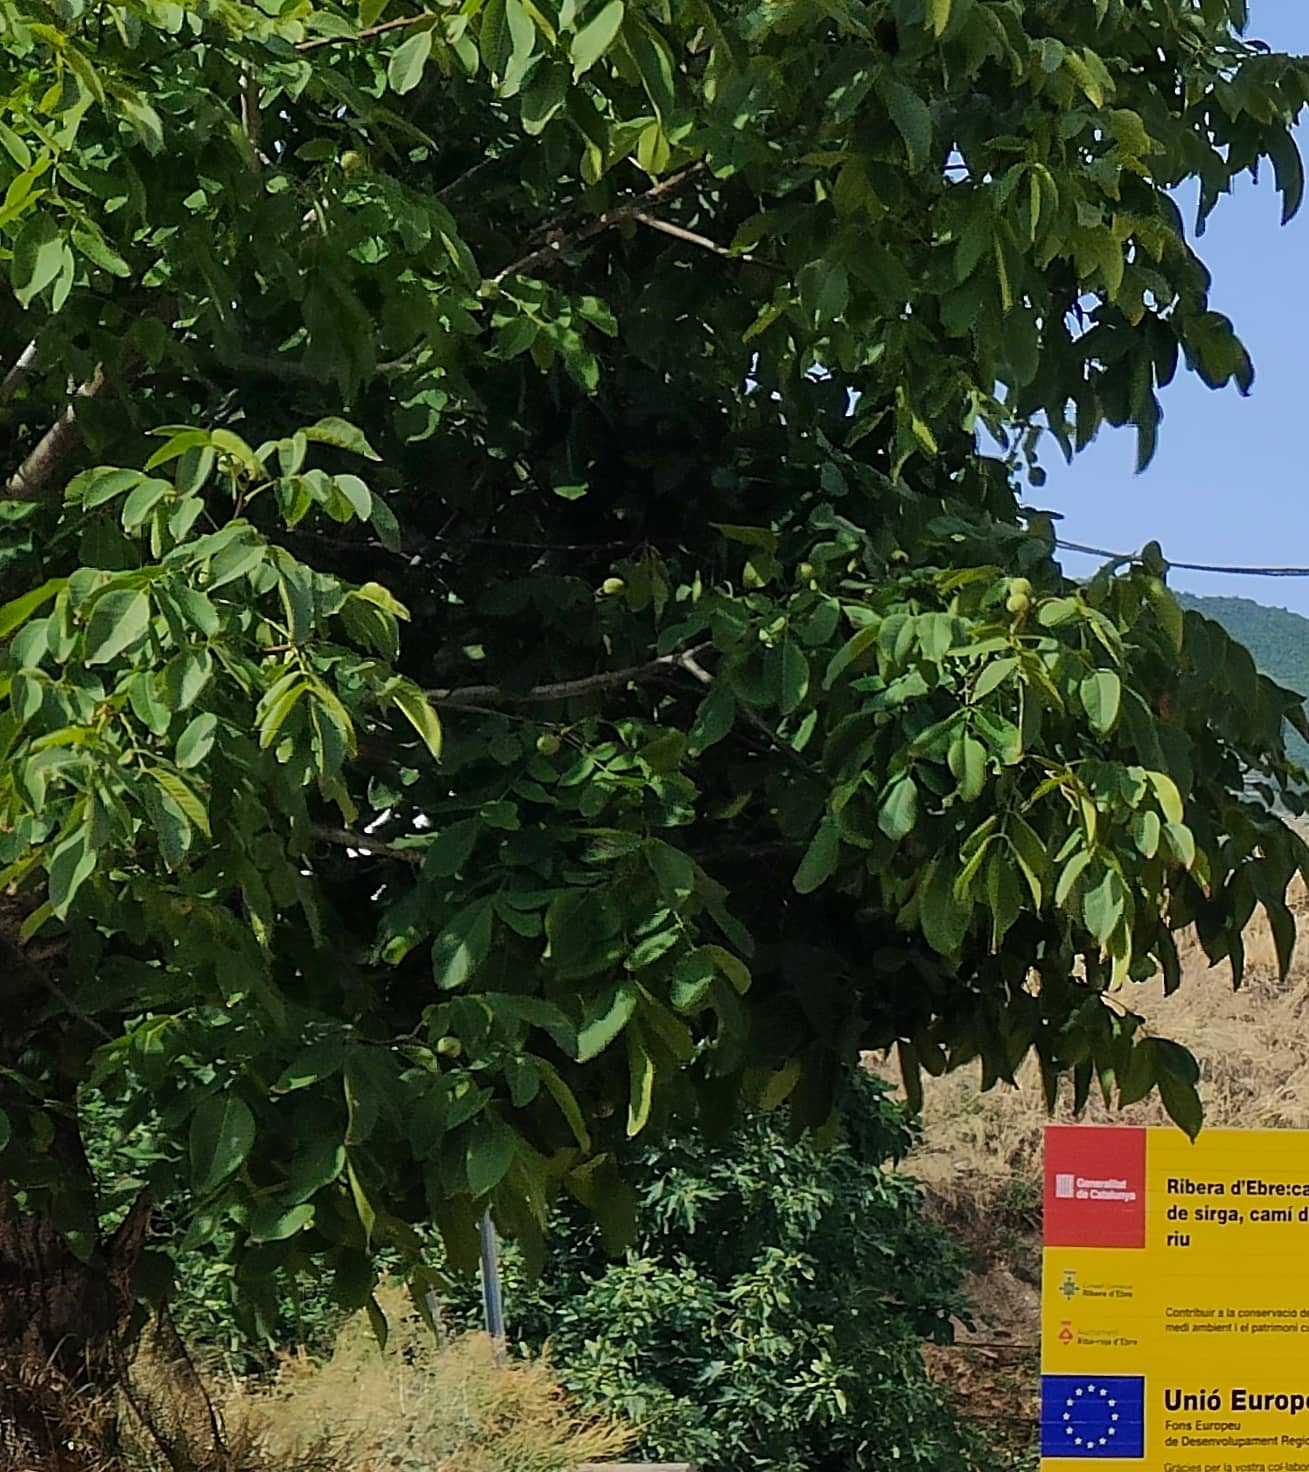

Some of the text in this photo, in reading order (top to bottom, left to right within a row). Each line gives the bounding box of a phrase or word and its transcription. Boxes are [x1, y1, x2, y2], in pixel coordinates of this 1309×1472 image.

[1167, 1178, 1224, 1195] Ribera
[1167, 1204, 1188, 1221] de
[1194, 1205, 1244, 1225] sirga,
[1250, 1206, 1293, 1222] camí
[1167, 1231, 1190, 1246] riu
[1165, 1388, 1221, 1411] Unió
[1165, 1420, 1241, 1432] Fons Europeu
[1165, 1436, 1178, 1447] de
[1181, 1436, 1278, 1448] Desenvolupament
